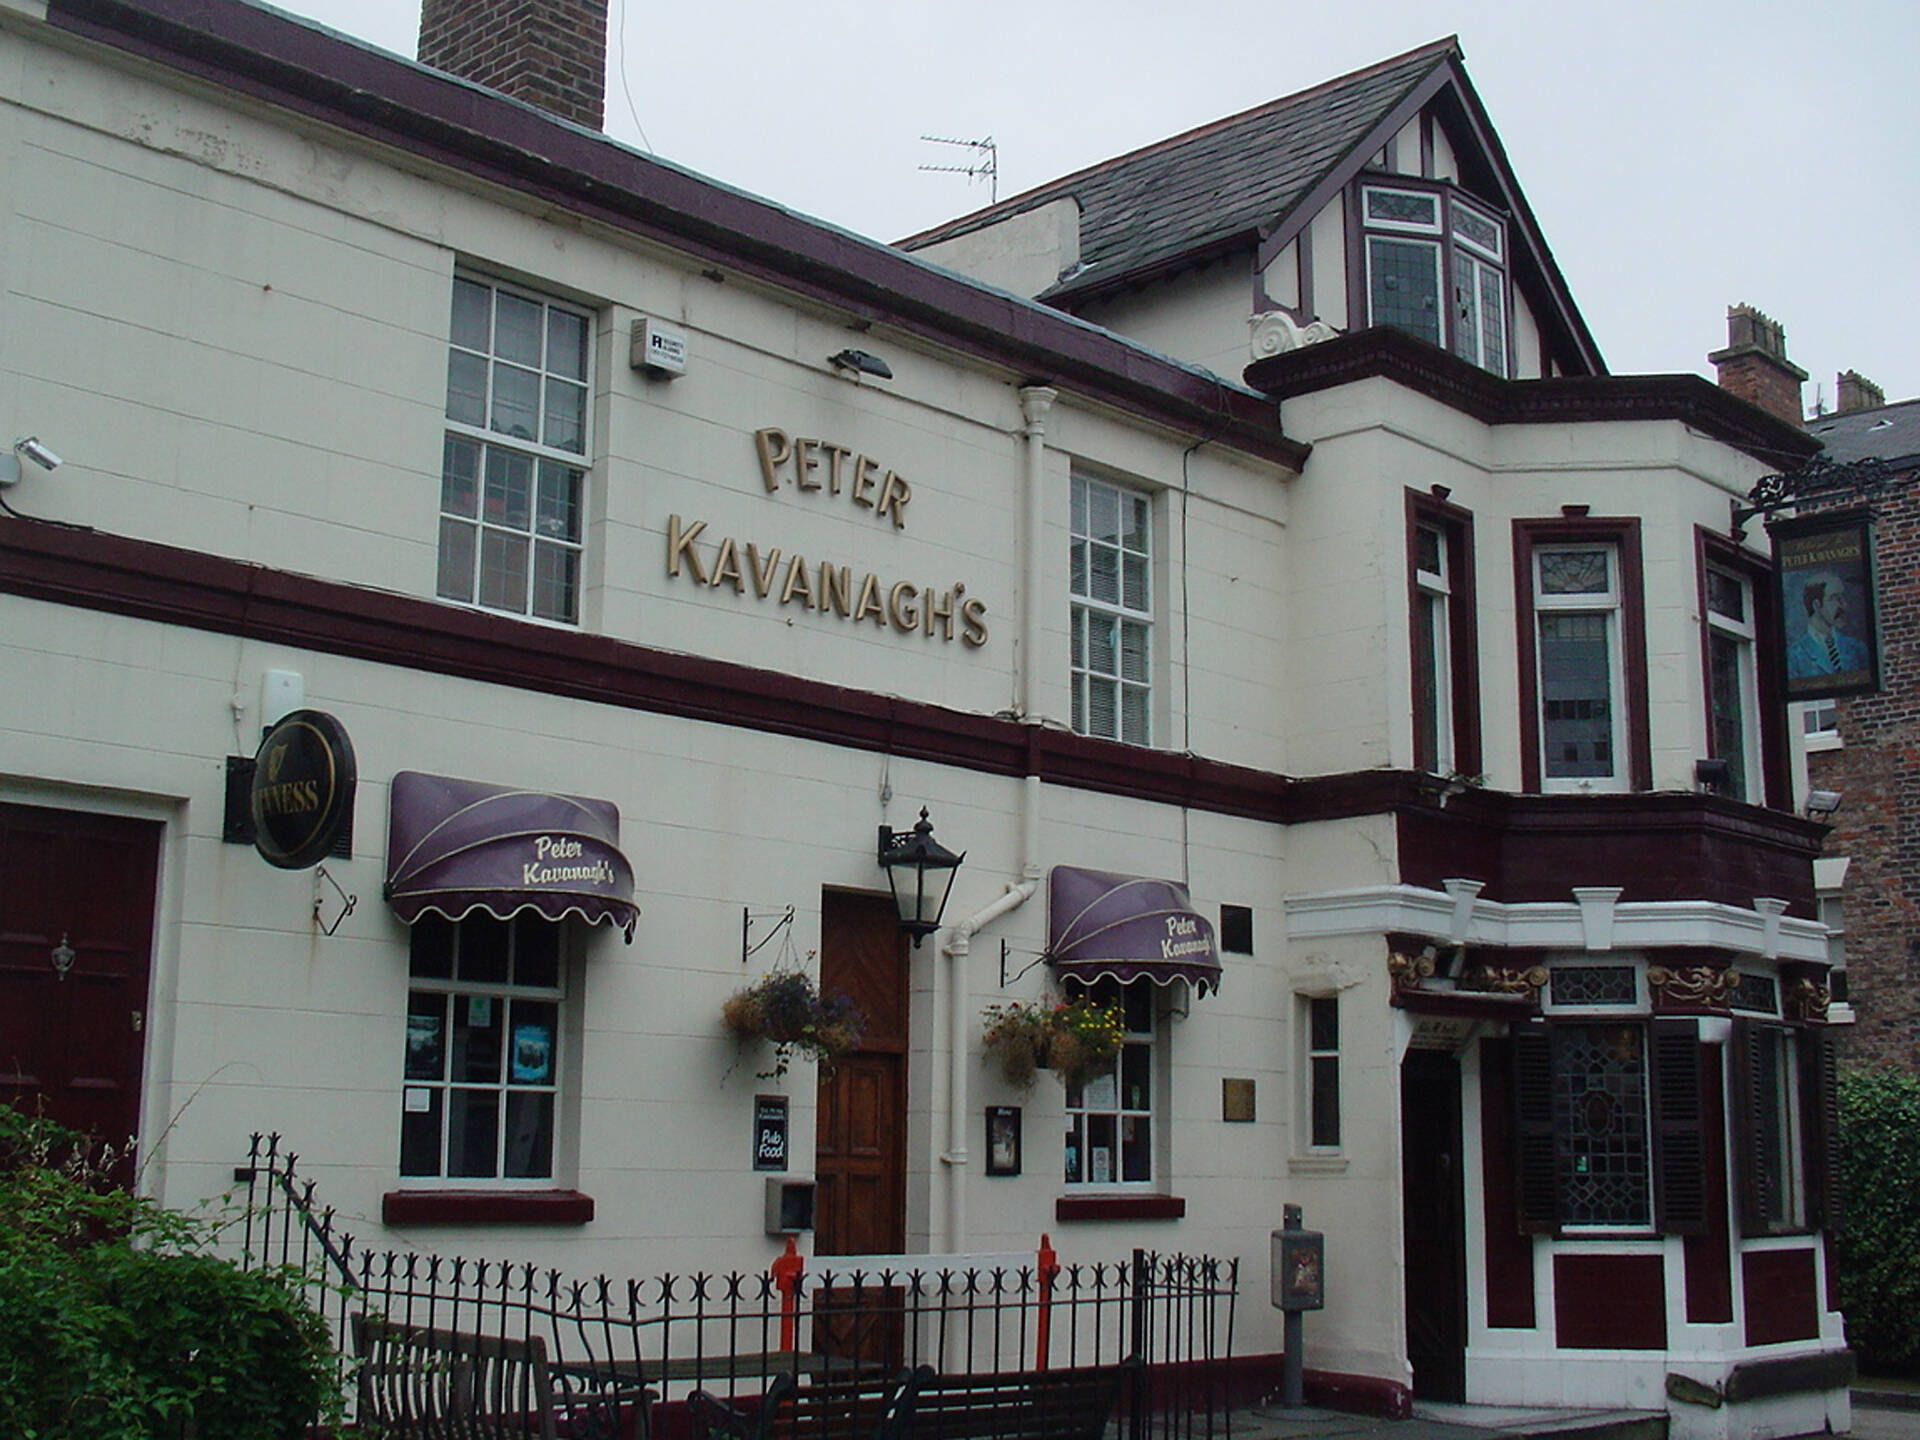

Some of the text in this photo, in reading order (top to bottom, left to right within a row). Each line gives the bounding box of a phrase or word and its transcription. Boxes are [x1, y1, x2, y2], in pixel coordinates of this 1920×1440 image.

[756, 427, 912, 530] PETER
[667, 513, 988, 648] KAVANAGH'S
[535, 836, 583, 860] Peter
[523, 860, 615, 885] Kavanagh's
[762, 1129, 781, 1144] Pub
[759, 1141, 784, 1158] Food
